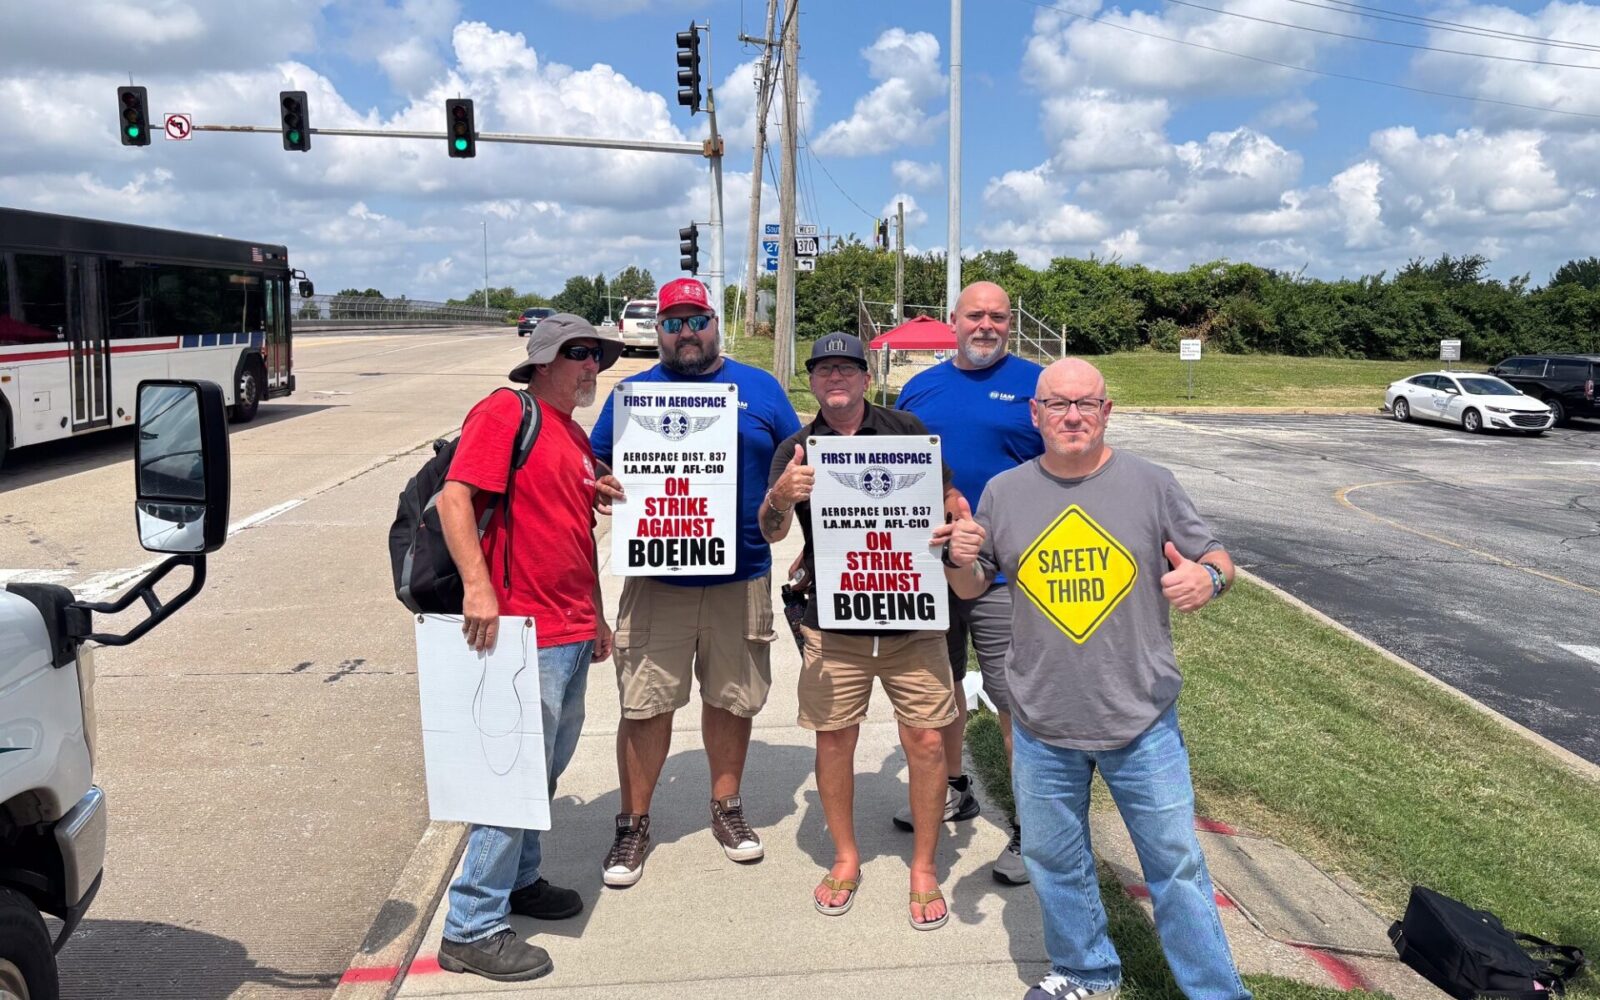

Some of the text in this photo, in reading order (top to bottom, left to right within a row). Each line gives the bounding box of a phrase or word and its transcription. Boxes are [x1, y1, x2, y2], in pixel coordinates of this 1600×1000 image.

[767, 242, 779, 252] 27
[798, 240, 814, 252] 370
[623, 395, 727, 408] FIRST IN AEROSPACE
[623, 452, 727, 462] AEROSPACE DIST. 837
[821, 452, 932, 464] FIRST IN AEROSPACE
[624, 464, 724, 474] I.A.M.A.W AFL-CIO
[665, 477, 689, 496] ON
[645, 497, 708, 517] STRIKE
[821, 506, 931, 516] AEROSPACE DIST. 837
[636, 518, 715, 537] AGAINST
[823, 519, 930, 529] I.A.M.A.W AFL-CIO
[866, 531, 892, 551] ON
[628, 537, 725, 567] BOEING
[846, 551, 914, 571] STRIKE
[1037, 546, 1110, 574] SAFETY
[840, 572, 921, 592] AGAINST
[1046, 577, 1105, 604] THIRD
[833, 592, 936, 621] BOEING
